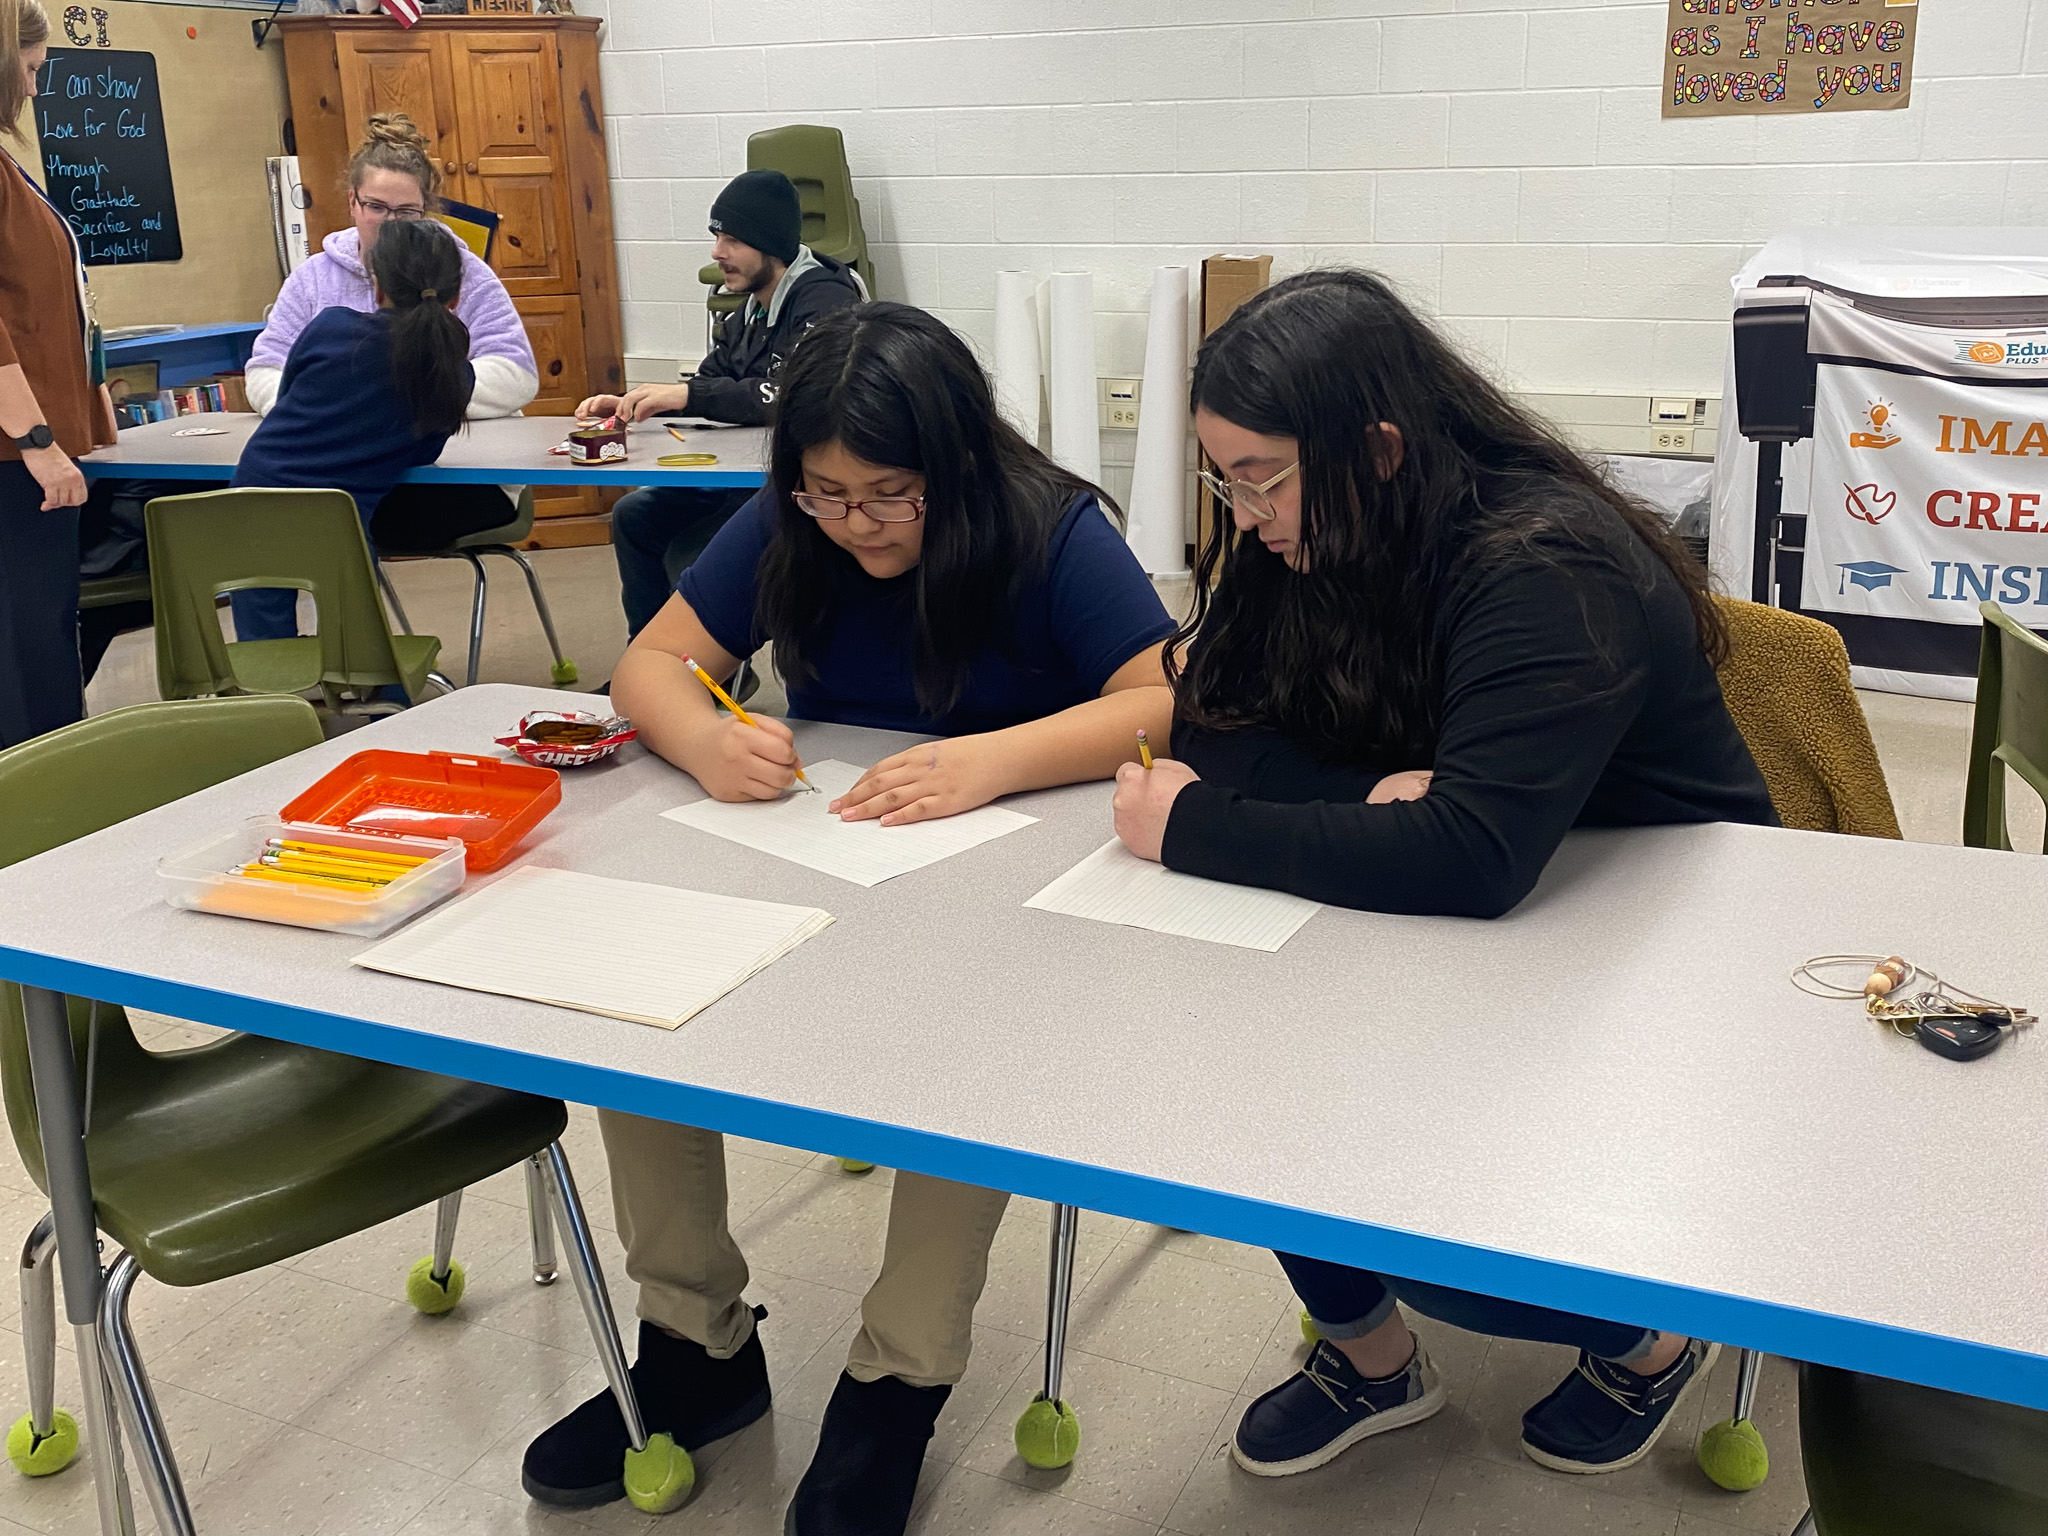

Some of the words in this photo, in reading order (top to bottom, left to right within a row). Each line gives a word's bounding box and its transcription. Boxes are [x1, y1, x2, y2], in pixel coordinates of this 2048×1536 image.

[63, 5, 111, 48] CI
[1671, 24, 1721, 57] as
[1739, 16, 1766, 58] I
[1785, 11, 1905, 55] have
[40, 57, 64, 97] I
[66, 74, 91, 99] can
[1673, 59, 1788, 106] loved
[1813, 61, 1902, 109] you
[43, 110, 79, 139] Love
[84, 107, 106, 137] for
[116, 108, 146, 138] God
[46, 154, 110, 191] through
[70, 185, 141, 212] Gratitude
[68, 211, 131, 237] Sacrifice
[141, 211, 162, 231] and
[90, 238, 149, 264] Loyalty
[2006, 342, 2048, 357] Edu
[2006, 357, 2040, 365] PLUS
[1926, 489, 2048, 533] CRE
